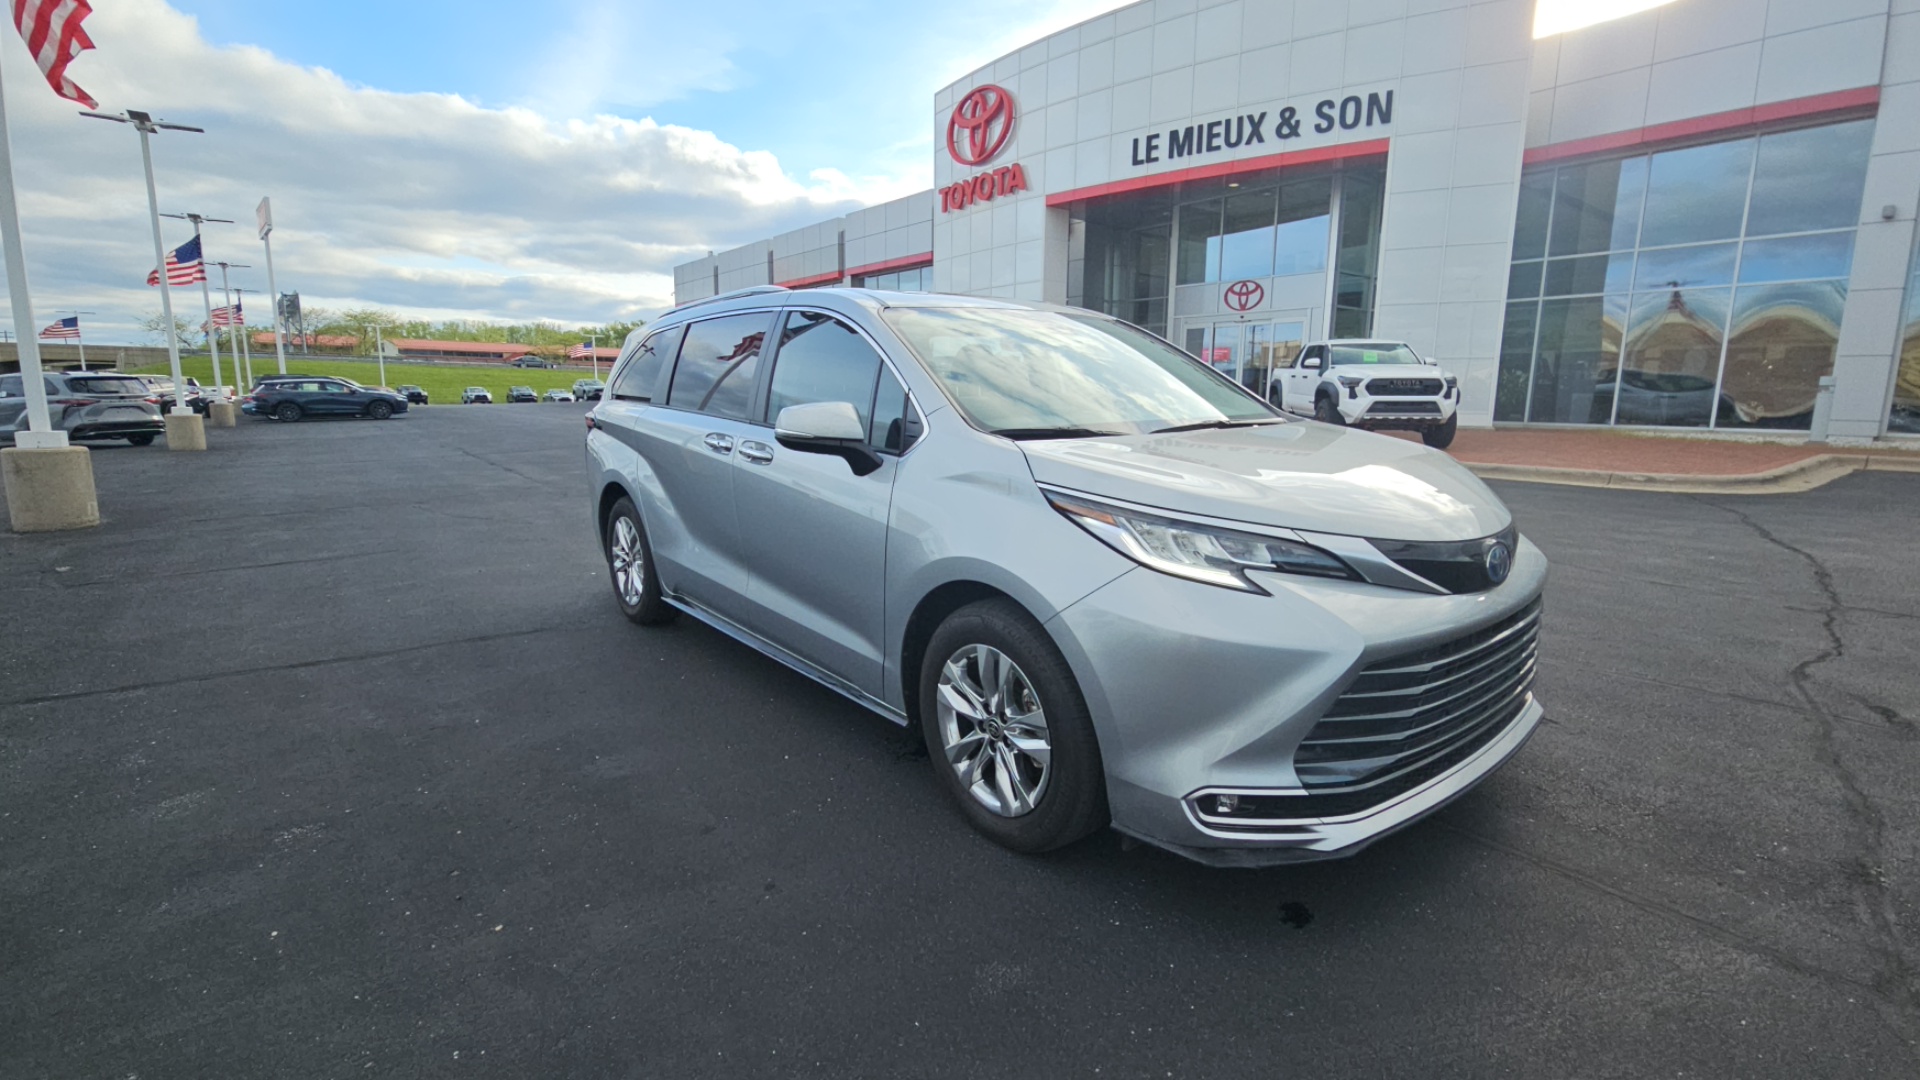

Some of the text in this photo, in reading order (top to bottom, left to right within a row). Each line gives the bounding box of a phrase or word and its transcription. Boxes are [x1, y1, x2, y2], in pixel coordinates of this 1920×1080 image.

[1131, 90, 1394, 166] LE MIEUX & SON
[939, 163, 1027, 213] TOYOTA
